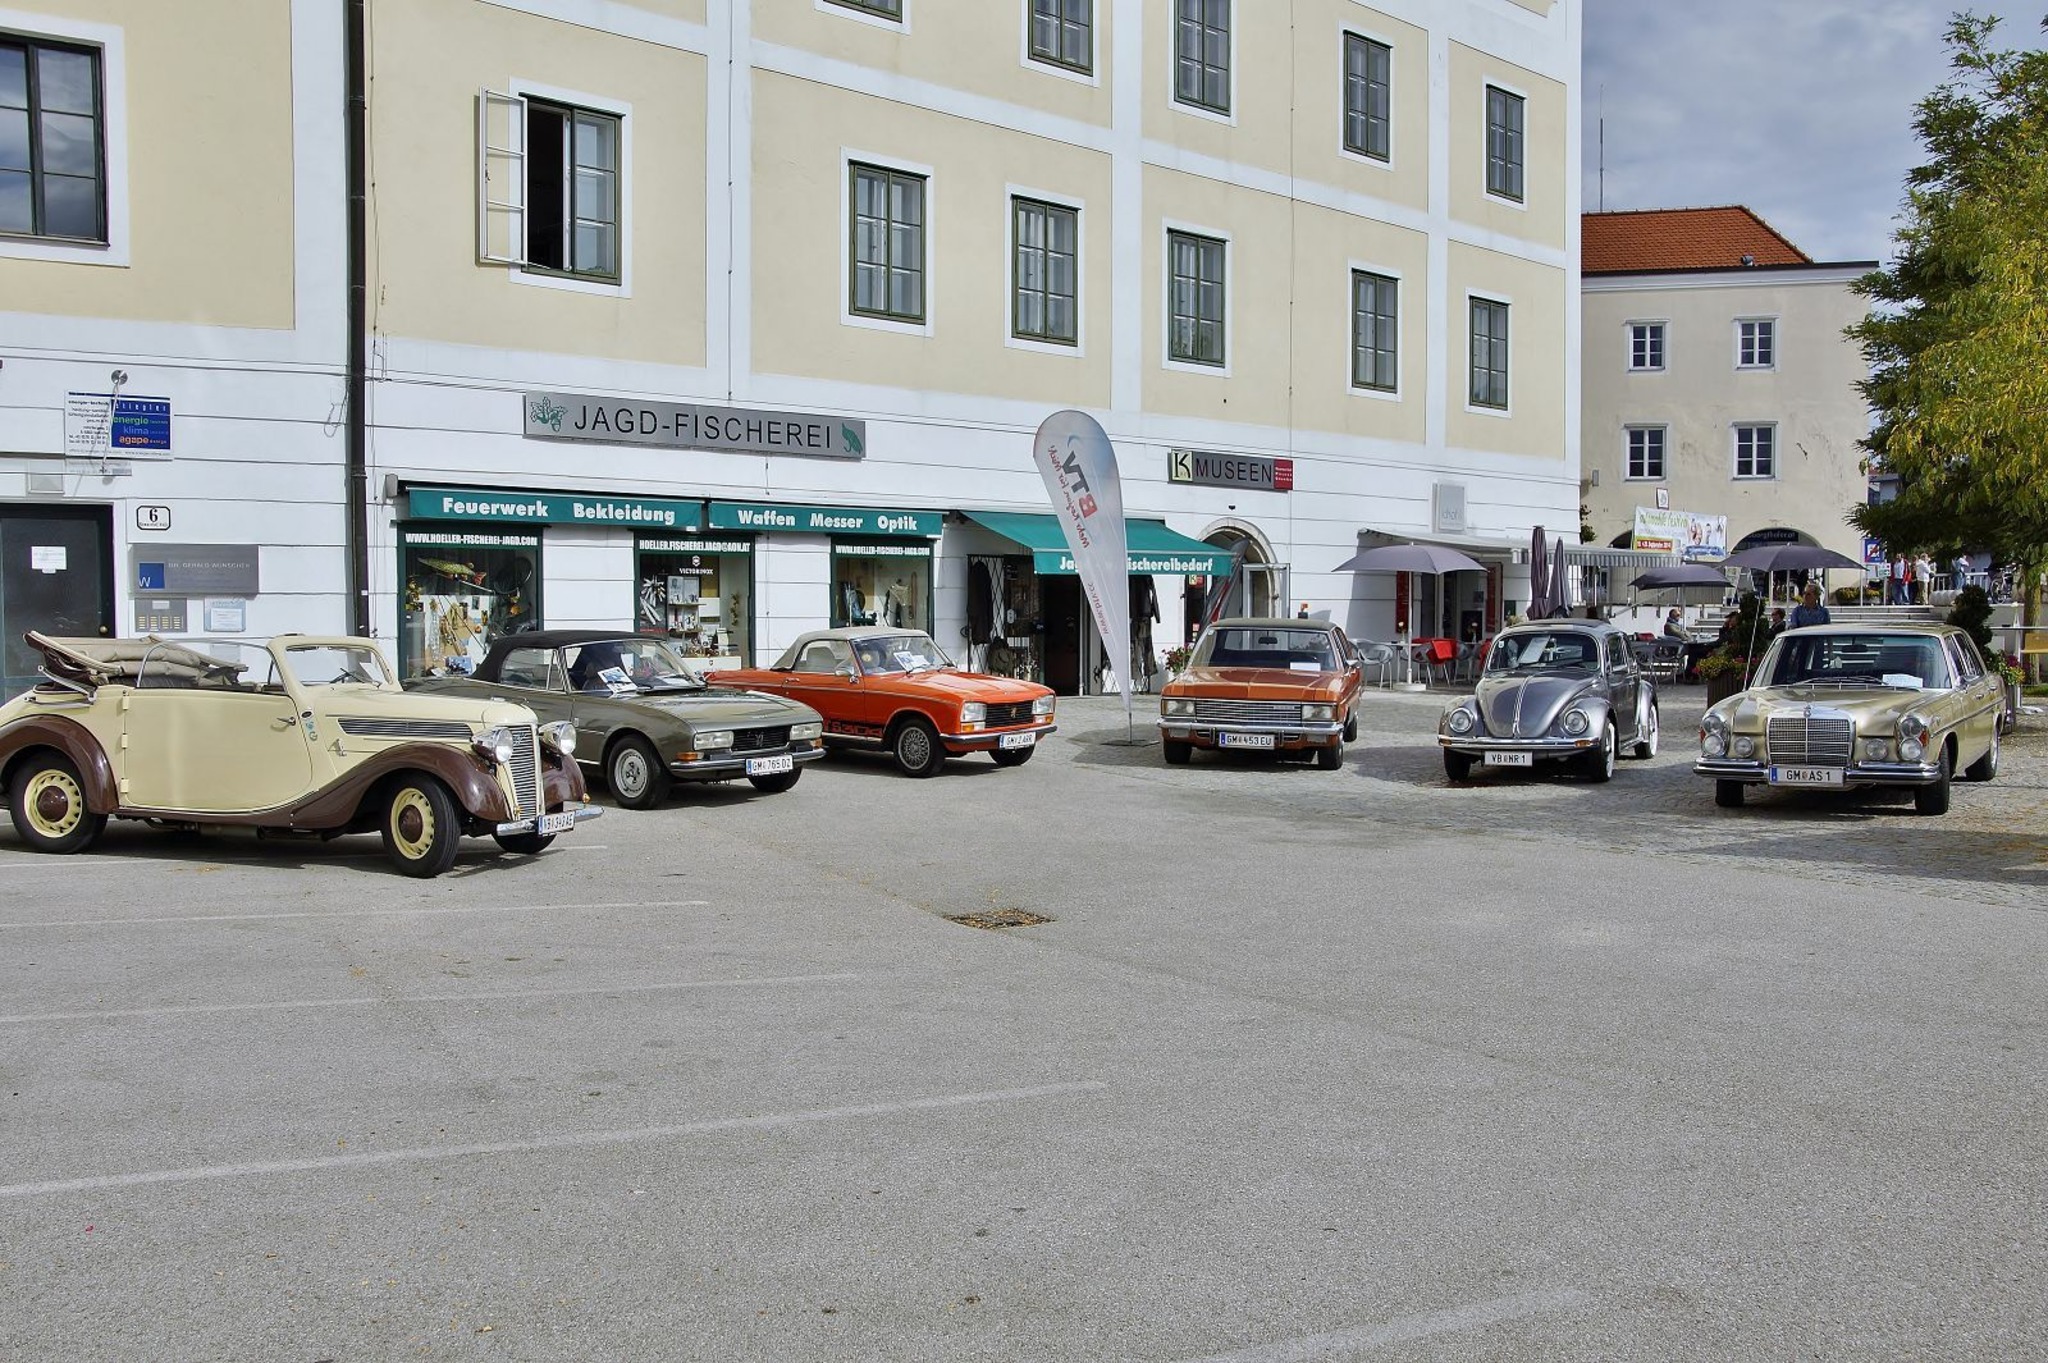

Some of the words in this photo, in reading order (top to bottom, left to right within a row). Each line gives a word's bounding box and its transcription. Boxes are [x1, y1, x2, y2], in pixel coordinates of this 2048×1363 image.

[123, 426, 149, 435] klima
[575, 404, 832, 449] JAGD-FISCHEREI
[1173, 452, 1191, 479] K
[1196, 458, 1272, 483] MUSEEN
[149, 507, 159, 522] 6
[442, 497, 549, 518] Feuerwerk
[572, 501, 676, 526] Bekleidung
[737, 509, 796, 527] Waffen
[810, 513, 864, 529] Messer
[877, 515, 918, 533] Optik
[405, 533, 539, 547] WWW.HOELLER-FISCHEREI-JAGD.COM
[1060, 556, 1079, 573] Ja
[1127, 556, 1213, 572] ischereibedarf
[139, 576, 151, 588] W
[1227, 735, 1238, 744] GM
[1491, 754, 1502, 763] VB
[1786, 769, 1801, 780] GM
[1808, 771, 1823, 781] AS
